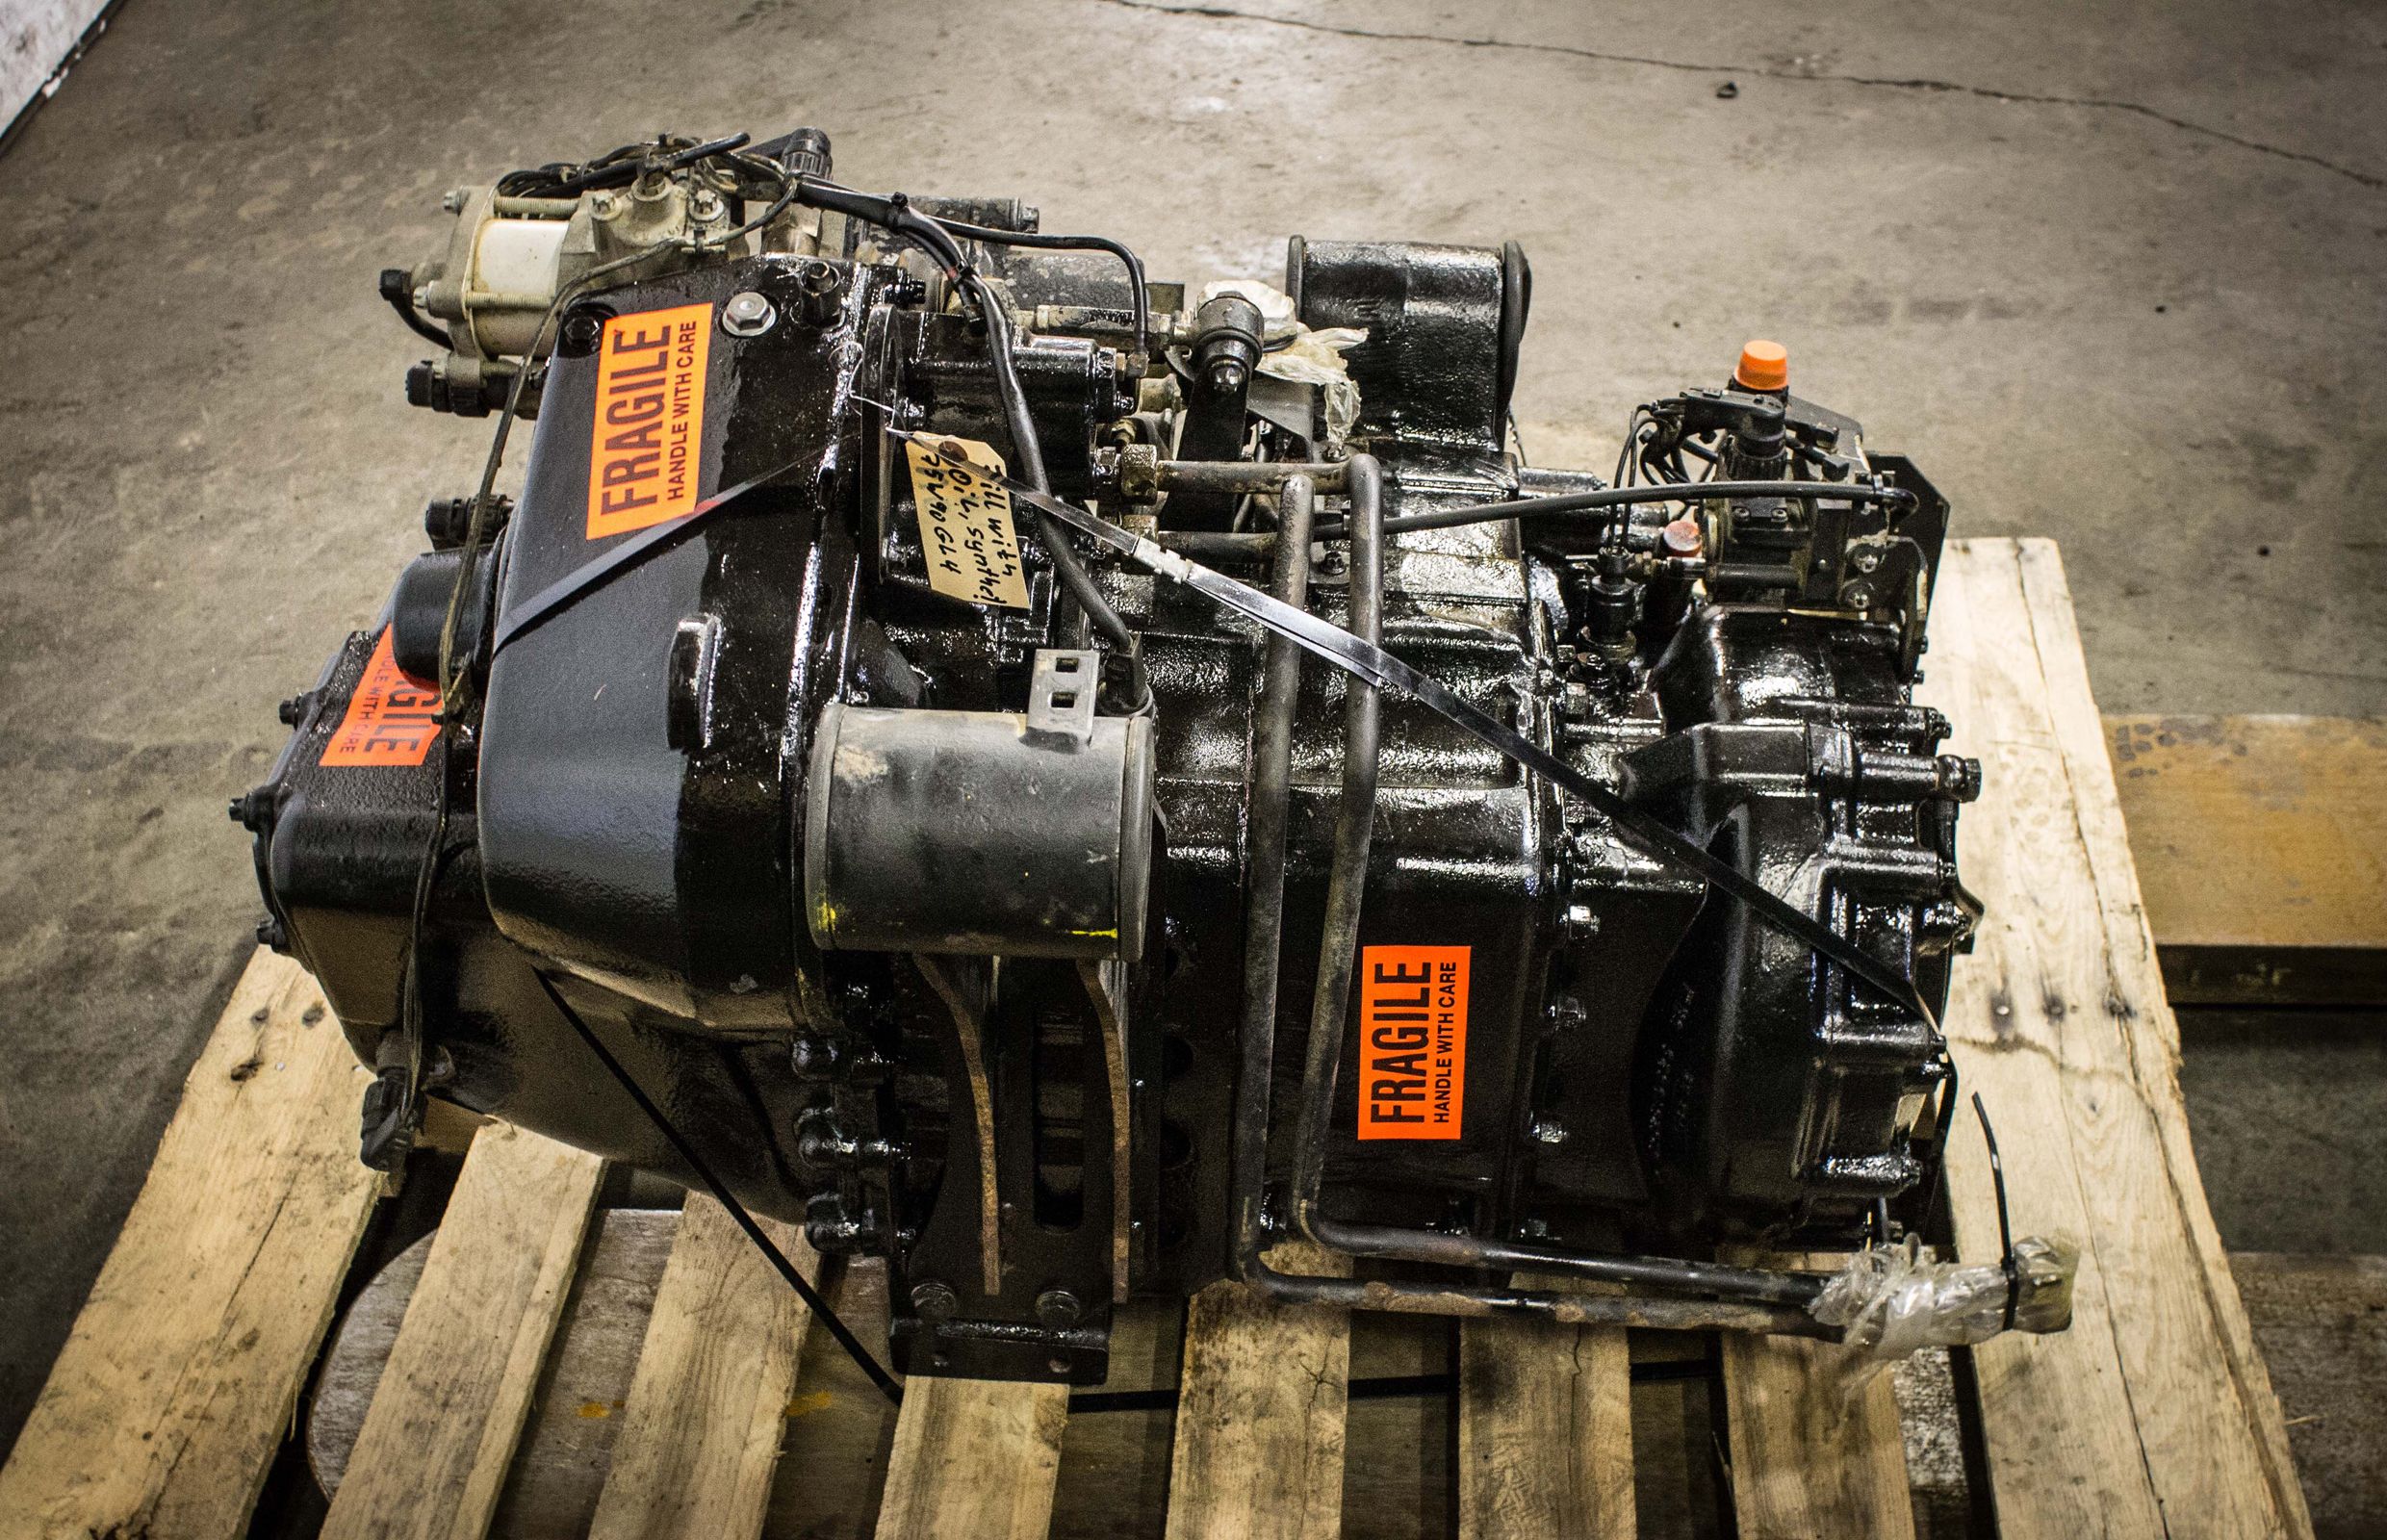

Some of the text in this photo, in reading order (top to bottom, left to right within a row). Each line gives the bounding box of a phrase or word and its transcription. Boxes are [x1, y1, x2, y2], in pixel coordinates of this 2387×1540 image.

[601, 325, 671, 515] FRAGILE
[667, 321, 697, 500] HANDLE WITH CARE
[988, 517, 1017, 578] with
[360, 687, 381, 721] WITH
[1371, 962, 1431, 1123] FRAGILE
[1433, 962, 1457, 1123] HANDLE WITH CARE
